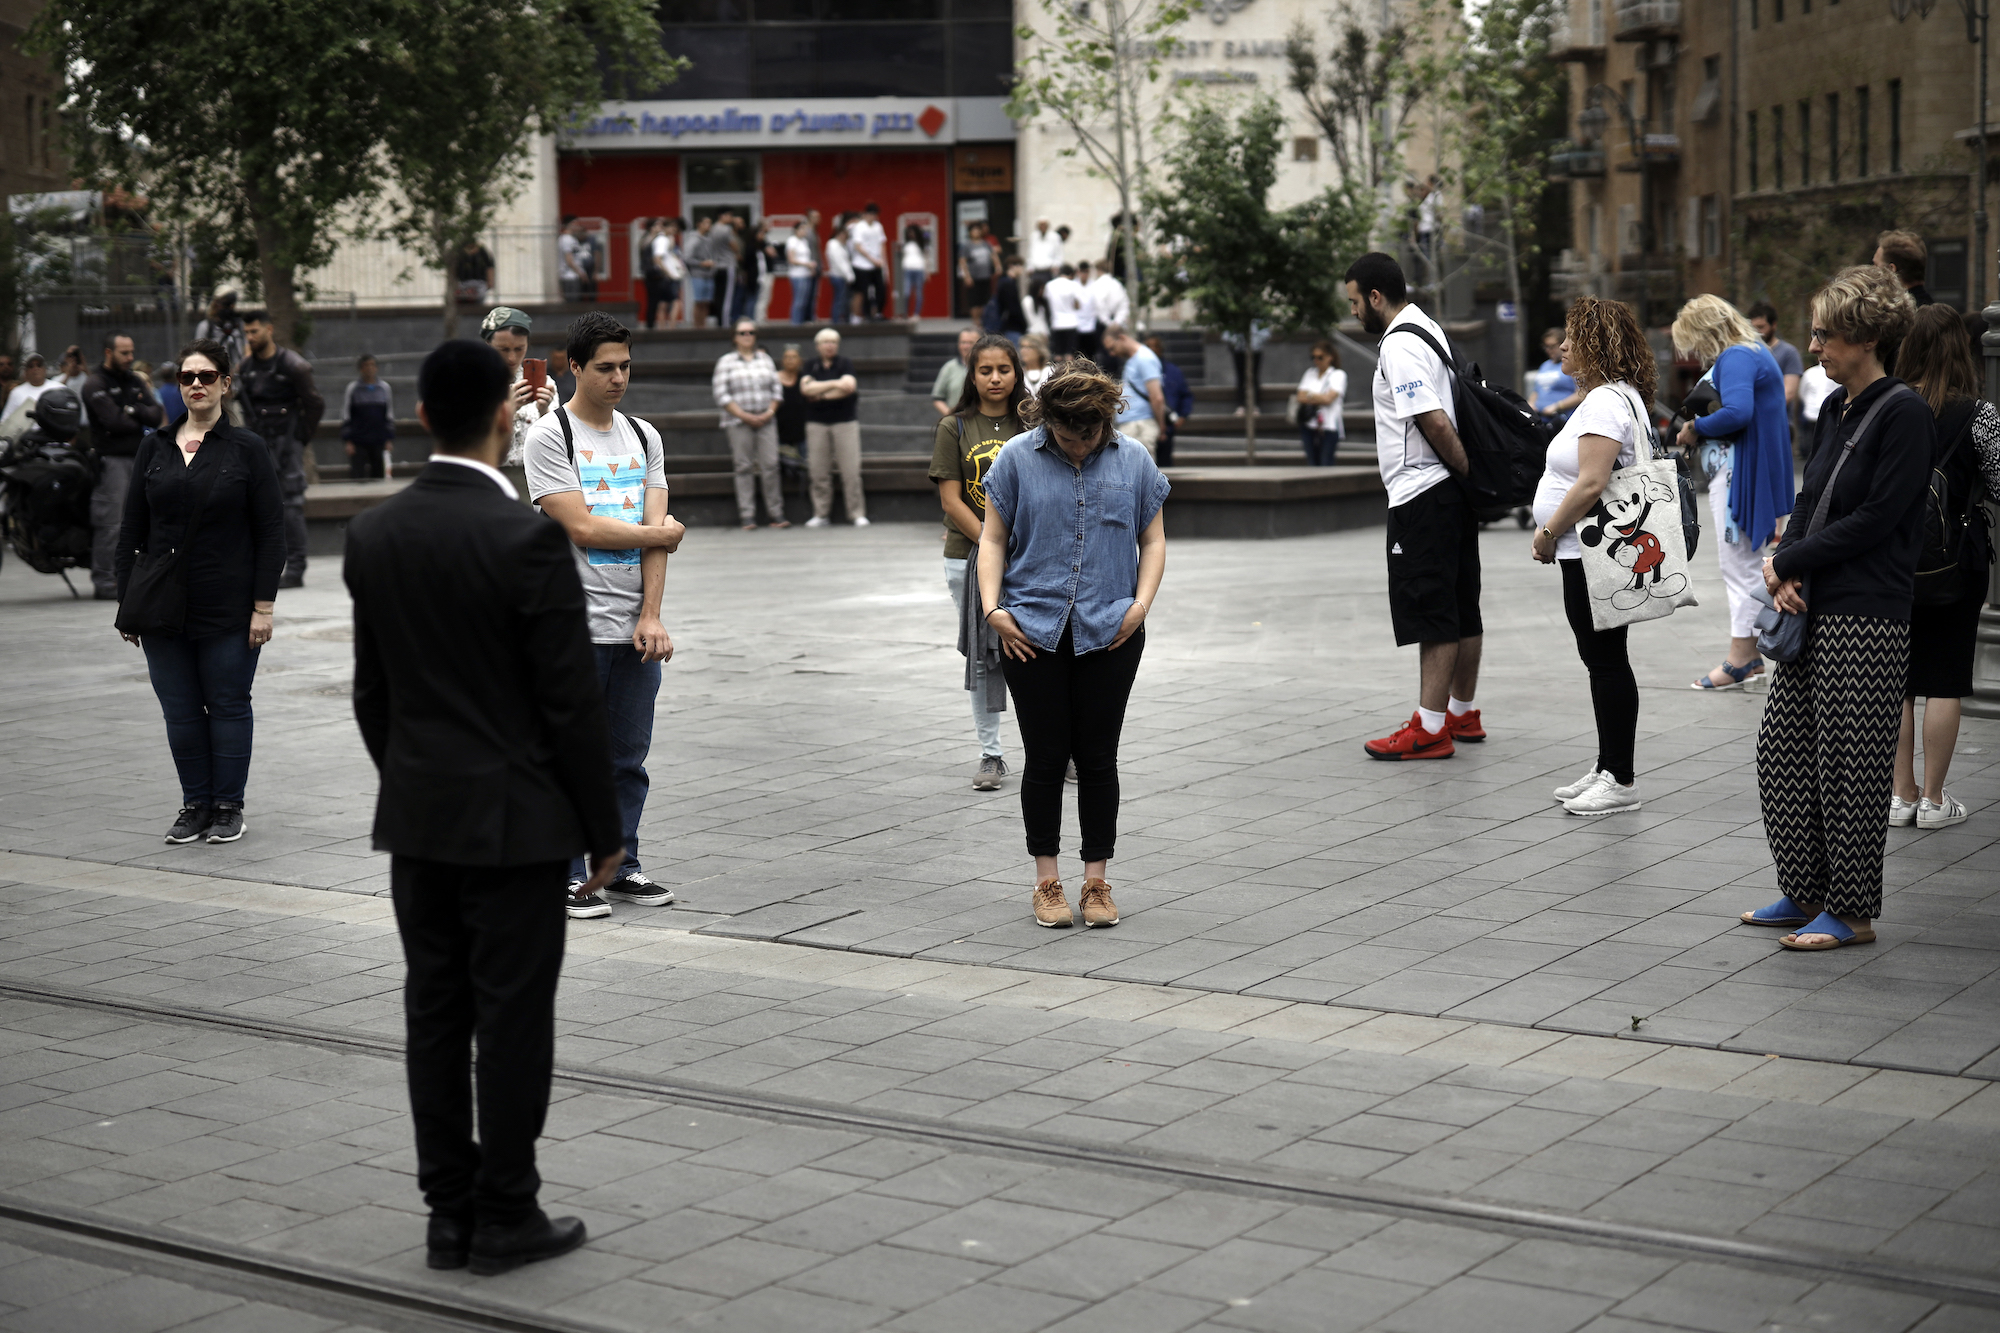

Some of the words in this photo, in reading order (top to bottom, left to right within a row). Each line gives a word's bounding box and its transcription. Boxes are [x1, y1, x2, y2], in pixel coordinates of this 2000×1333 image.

[640, 109, 762, 138] hapoalim
[770, 107, 866, 133] הפועלים
[871, 110, 914, 135] בנק
[1395, 384, 1408, 394] יהב
[1408, 380, 1423, 390] בנק
[965, 443, 982, 462] ISRAEL
